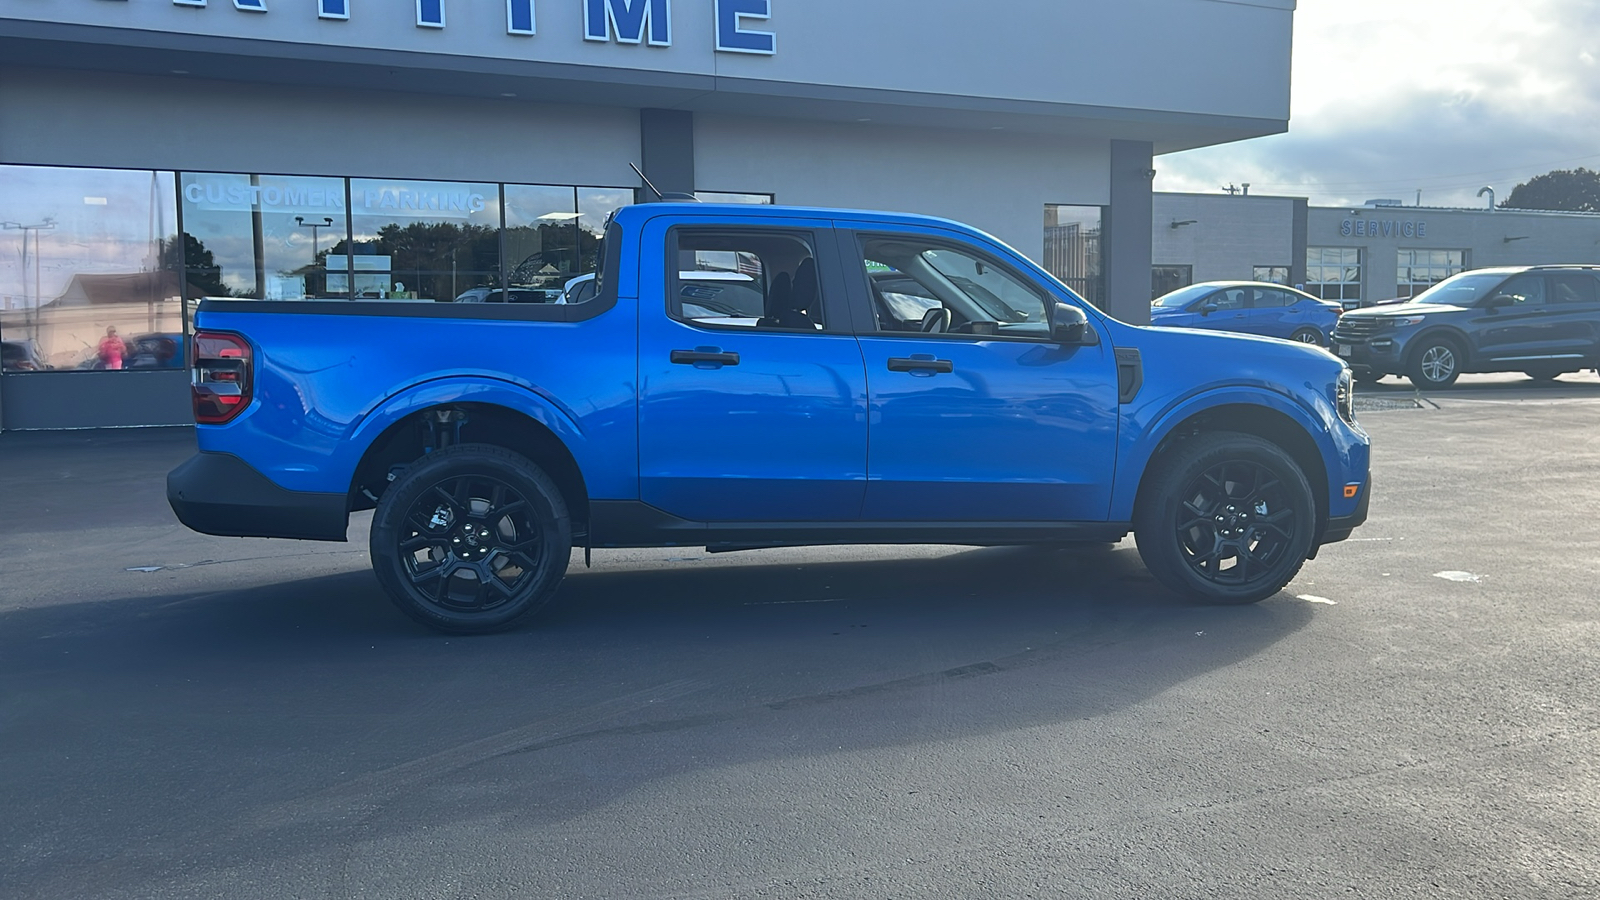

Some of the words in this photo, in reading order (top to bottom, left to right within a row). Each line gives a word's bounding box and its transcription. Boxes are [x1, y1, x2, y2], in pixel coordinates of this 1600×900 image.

[185, 183, 343, 208] CUSTOMER
[363, 188, 486, 212] PARKING
[1341, 219, 1427, 238] SERVICE
